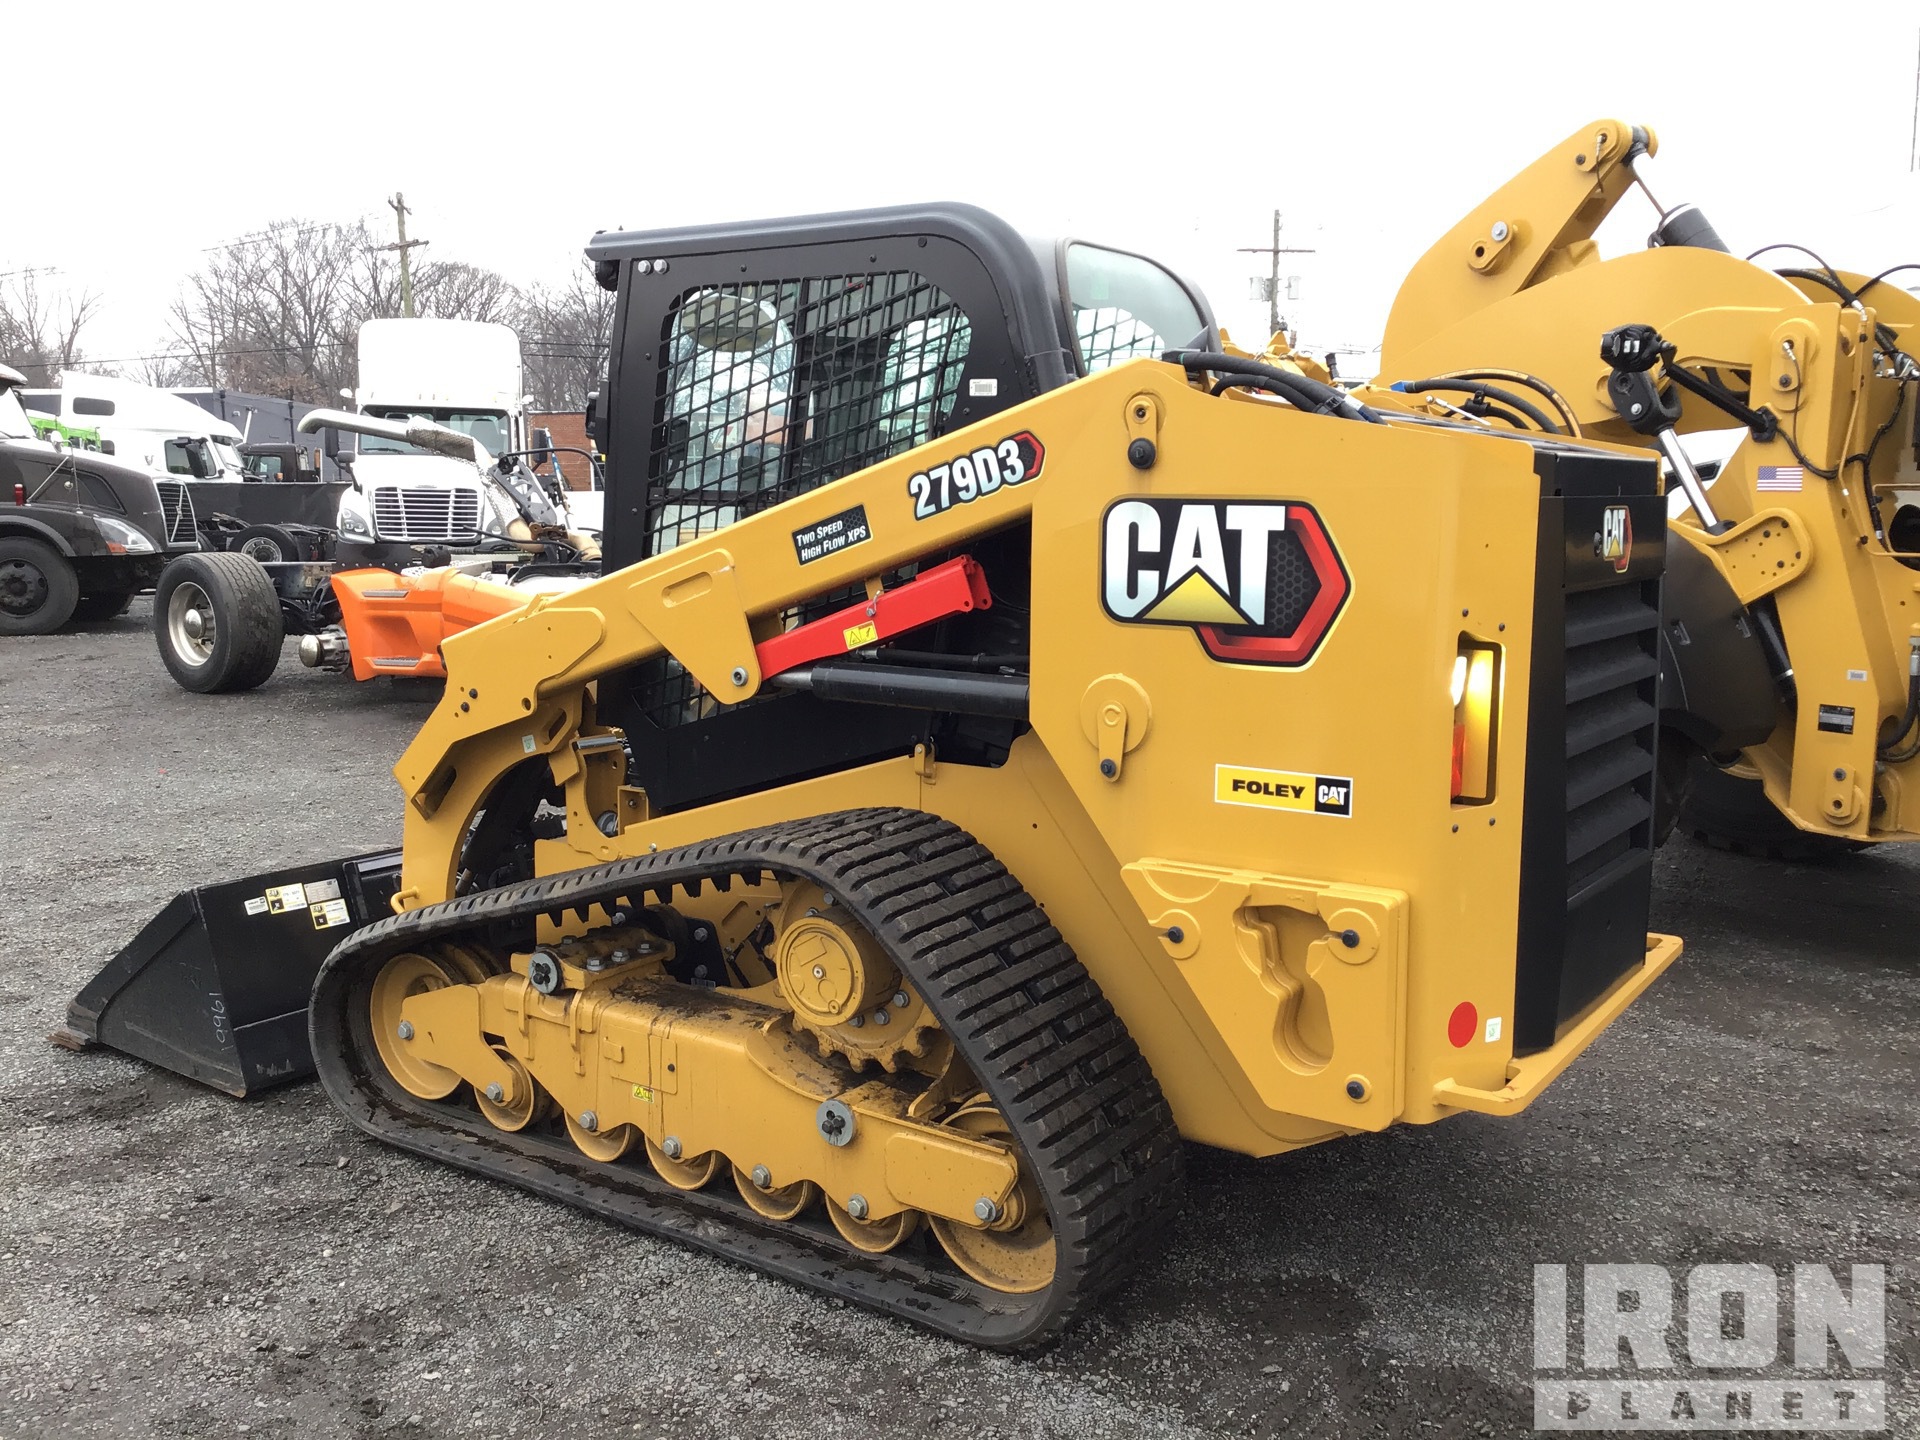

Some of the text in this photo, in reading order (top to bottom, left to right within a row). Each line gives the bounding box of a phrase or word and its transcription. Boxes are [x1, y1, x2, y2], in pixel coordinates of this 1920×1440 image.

[909, 439, 1025, 518] 279D3
[847, 525, 866, 543] XPS
[1603, 509, 1626, 557] CAT
[1105, 501, 1286, 626] CAT
[1232, 779, 1348, 806] FOLEY CAT
